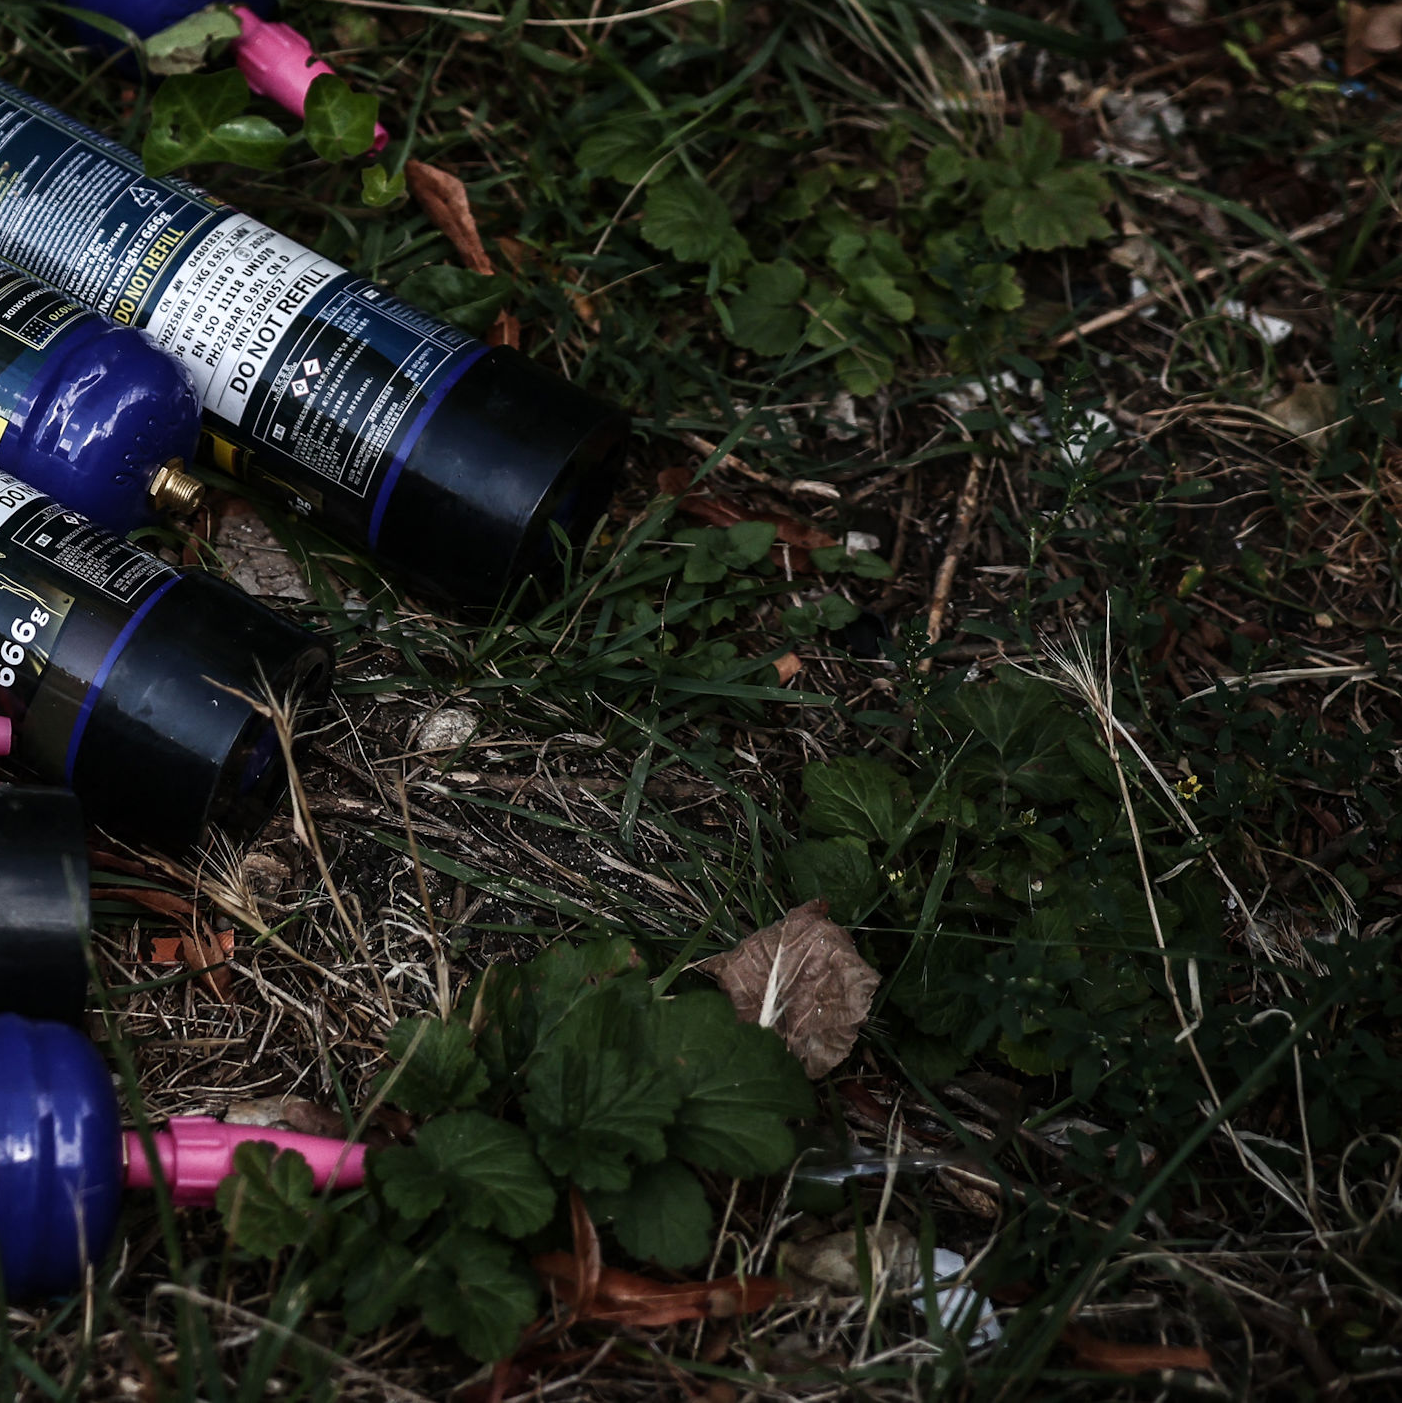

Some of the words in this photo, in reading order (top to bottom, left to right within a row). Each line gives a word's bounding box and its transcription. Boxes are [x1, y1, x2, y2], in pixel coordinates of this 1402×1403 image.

[96, 284, 118, 313] Net
[110, 236, 147, 289] weight:
[140, 209, 173, 240] 666g
[124, 266, 155, 302] NOT
[143, 225, 186, 272] REFILL
[158, 297, 172, 313] CN
[187, 227, 225, 268] 04801835
[186, 267, 211, 296] 1.5KG
[206, 245, 230, 268] 0.95L
[112, 296, 138, 325] DO
[182, 325, 196, 341] EN
[191, 303, 208, 324] ISO
[203, 273, 229, 302] 11118
[191, 340, 207, 358] EN
[202, 314, 221, 337] ISO
[217, 278, 245, 311] 11118
[241, 247, 276, 277] UN1070
[205, 305, 246, 367] PH225BAR
[242, 276, 268, 303] 0.95L
[265, 261, 282, 276] CN
[228, 359, 258, 395] DO
[246, 313, 284, 360] NOT
[276, 269, 330, 315] REFILL
